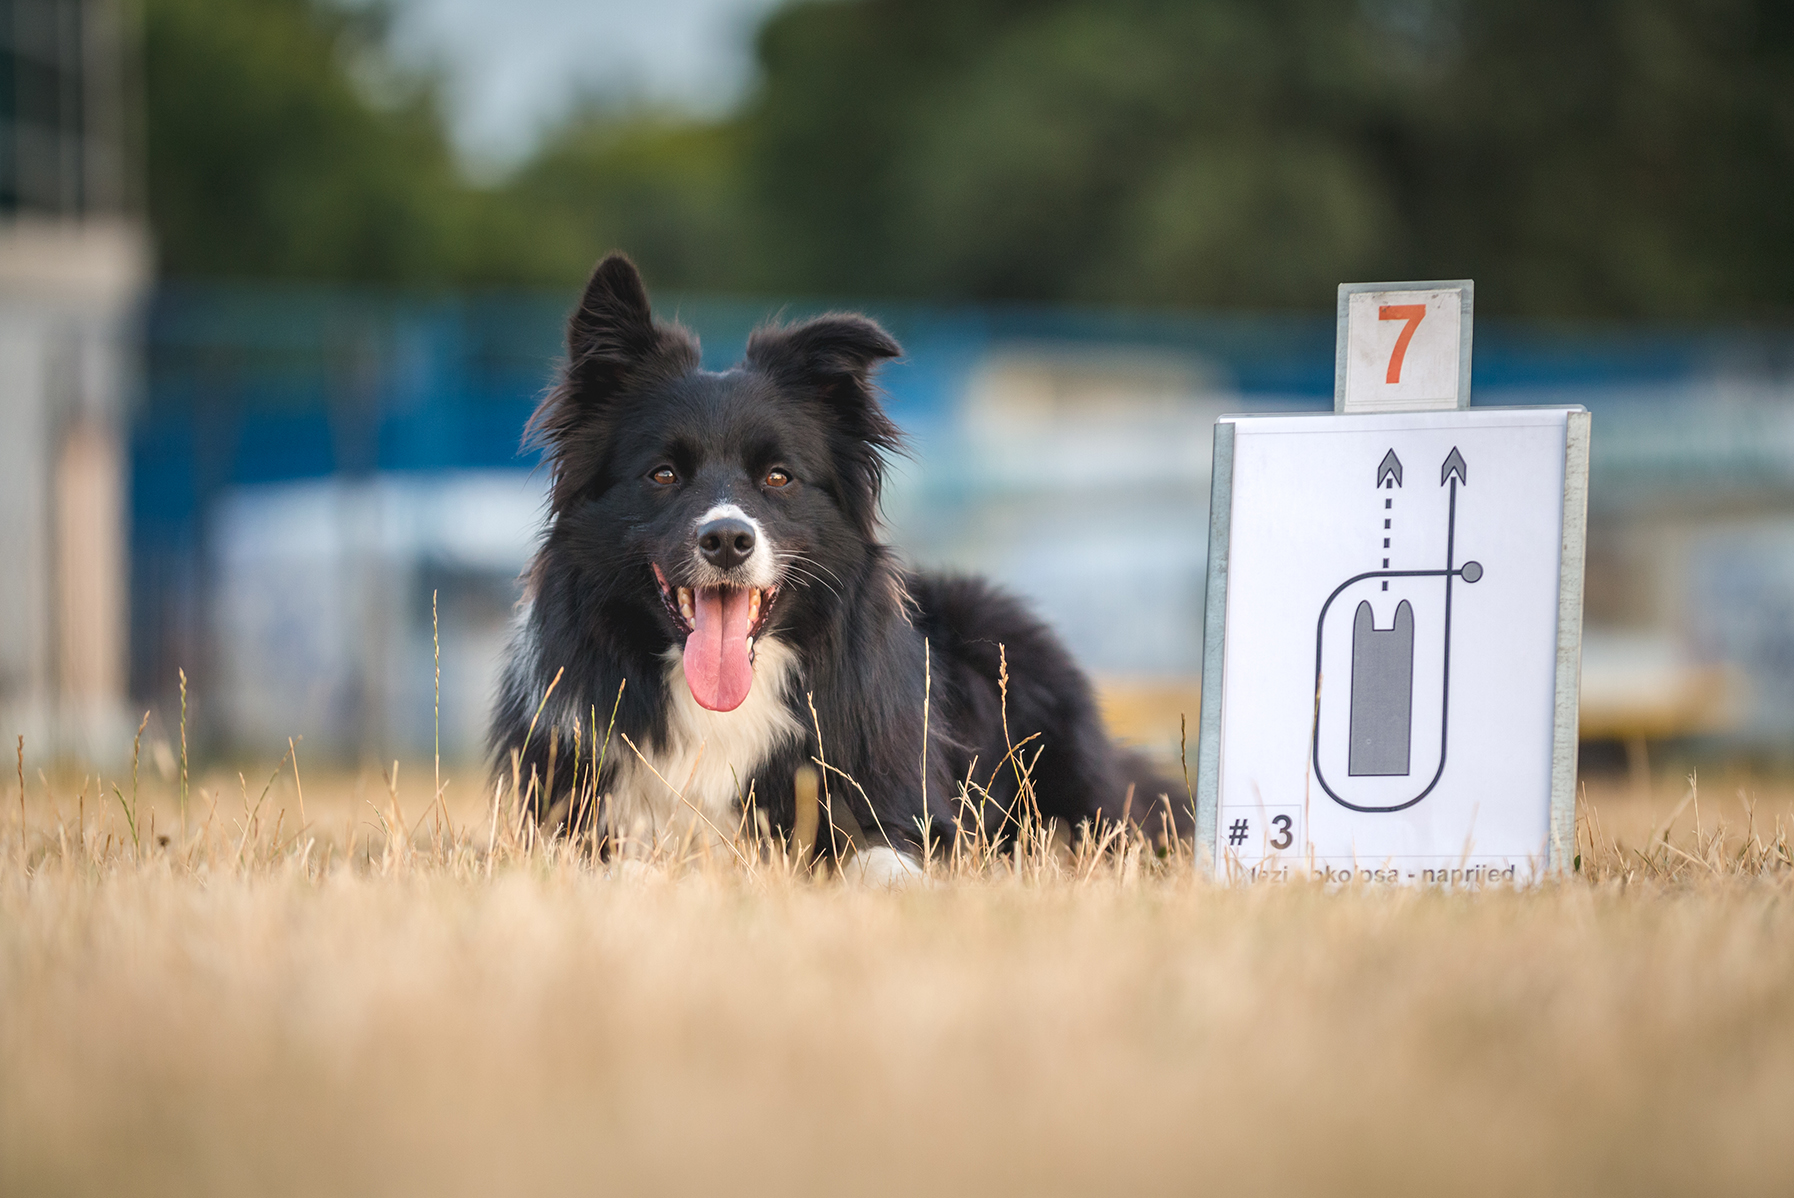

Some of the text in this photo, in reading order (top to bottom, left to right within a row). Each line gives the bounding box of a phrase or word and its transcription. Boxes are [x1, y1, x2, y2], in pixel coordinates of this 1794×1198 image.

[1378, 304, 1426, 384] 7
[1229, 814, 1293, 850] # 3
